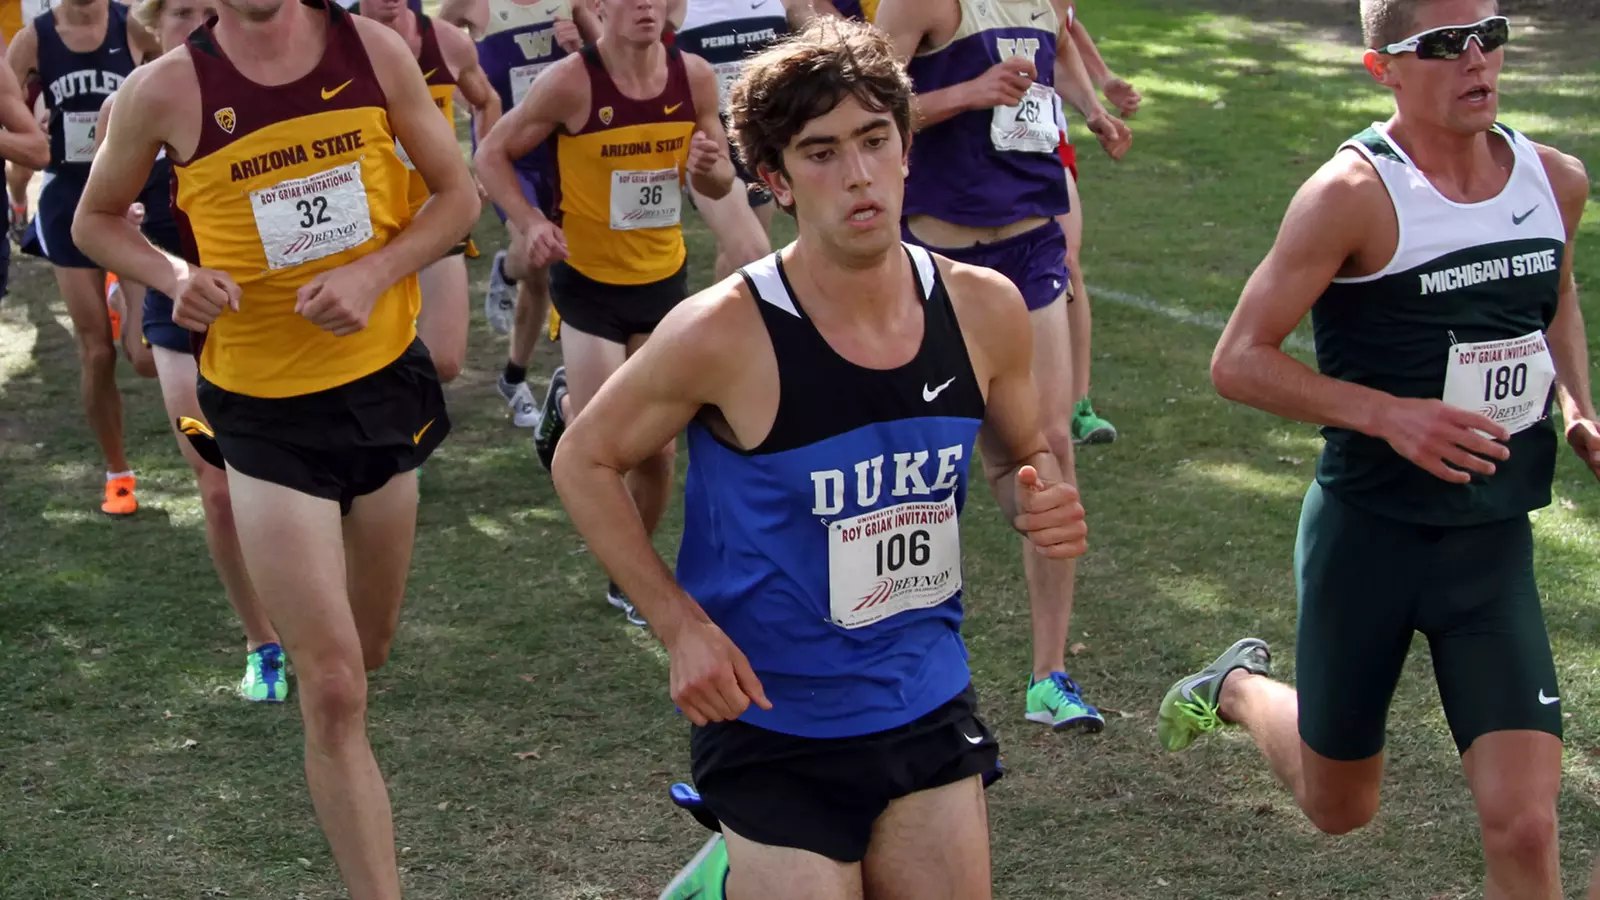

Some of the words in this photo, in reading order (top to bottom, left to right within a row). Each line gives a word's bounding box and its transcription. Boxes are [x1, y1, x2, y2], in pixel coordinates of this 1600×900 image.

[514, 26, 556, 60] W
[701, 34, 735, 48] PENN
[737, 28, 775, 45] STATE
[996, 37, 1040, 76] W
[230, 144, 308, 182] ARIZONA
[311, 129, 366, 159] STATE
[601, 141, 652, 158] ARIZONA
[260, 191, 277, 206] ROY
[278, 186, 302, 200] GRIAK
[302, 171, 353, 195] INVITATIONAL
[639, 185, 663, 206] 36
[296, 196, 332, 228] 32
[1419, 257, 1509, 295] MICHIGAN
[1512, 249, 1556, 277] STATE
[1459, 352, 1476, 365] ROY
[1478, 348, 1503, 363] GRIAK
[1484, 362, 1528, 402] 180
[810, 444, 963, 515] DUKE
[842, 526, 862, 543] ROY
[865, 517, 893, 537] GRIAK
[857, 508, 894, 524] UNIVERSITY
[906, 502, 948, 511] MINNESOTA
[876, 529, 931, 577] 106
